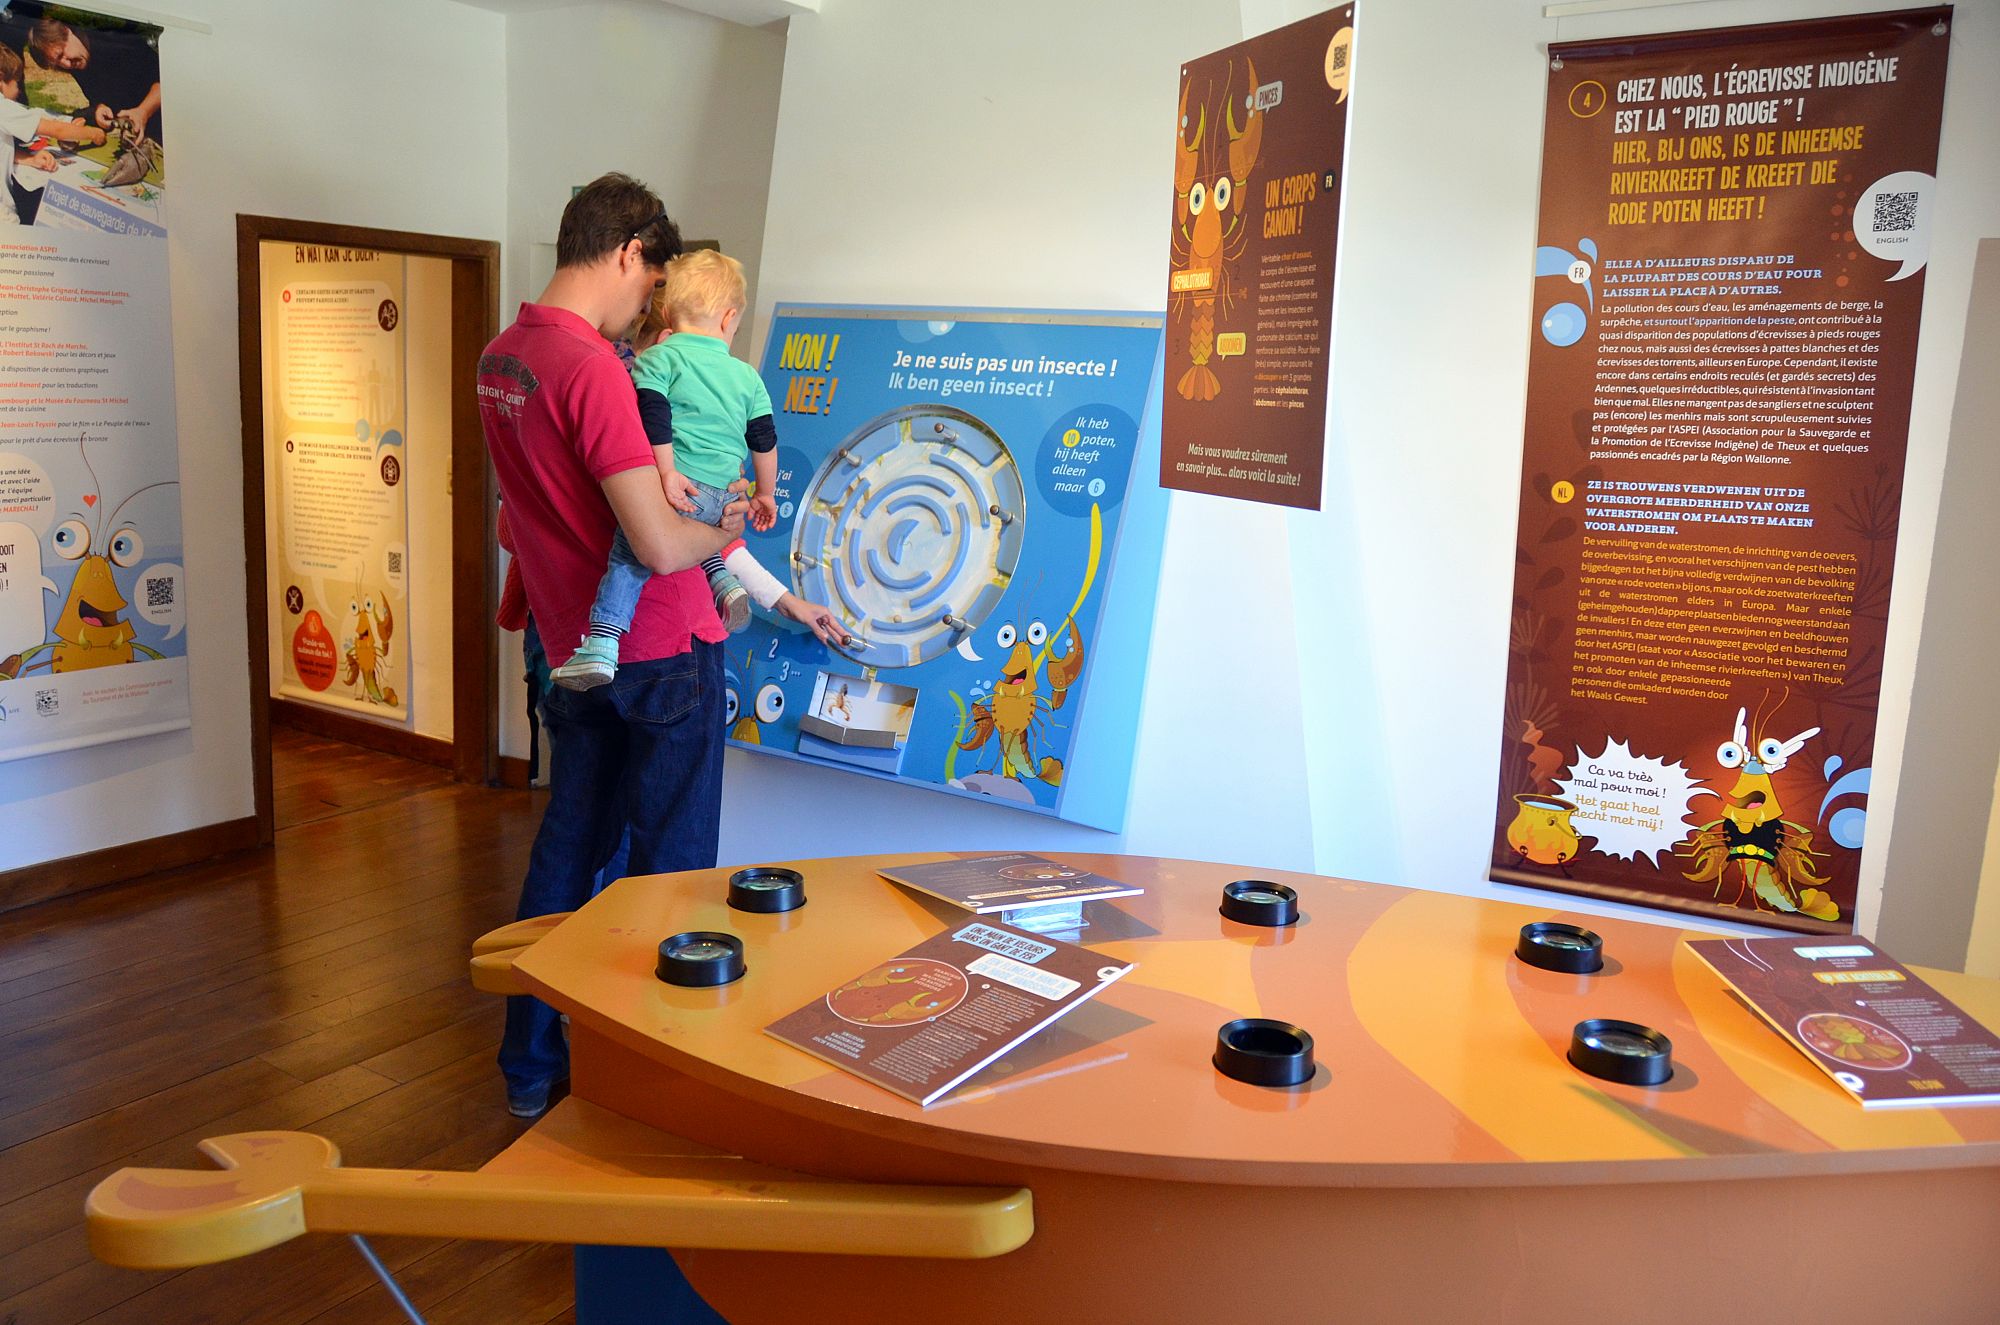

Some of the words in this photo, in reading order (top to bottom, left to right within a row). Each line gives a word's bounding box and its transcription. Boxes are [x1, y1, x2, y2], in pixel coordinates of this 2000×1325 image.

[1617, 77, 1654, 103] CHEZ
[1661, 73, 1707, 100] NOUS,
[1818, 52, 1899, 87] INDIGÈNE
[1259, 87, 1278, 107] PINCES
[1583, 91, 1591, 109] 4
[1614, 109, 1641, 134] EST
[1647, 108, 1665, 131] LA
[1684, 102, 1720, 129] PIED
[1725, 99, 1779, 126] ROUGE
[1613, 139, 1651, 165] HIER,
[1657, 135, 1684, 161] BIJ
[1689, 134, 1727, 160] ONS,
[1733, 132, 1749, 157] IS
[1755, 131, 1775, 156] DE
[1781, 125, 1864, 155] INHEEMSE
[1325, 175, 1333, 188] FR
[1611, 165, 1715, 195] RIVIERKREEFT
[1720, 163, 1740, 190] DE
[1745, 160, 1805, 189] KREEFT
[1811, 159, 1838, 184] DIE
[1265, 179, 1280, 208] UN
[1282, 172, 1317, 206] CORPS
[47, 185, 68, 206] Projet
[69, 196, 79, 211] de
[80, 203, 126, 233] sauvegarde
[1608, 199, 1646, 225] RODE
[1652, 197, 1701, 223] POTEN
[1707, 196, 1754, 221] HEEFT
[1263, 209, 1296, 239] CANON
[1876, 235, 1908, 244] ENGLISH
[296, 246, 304, 263] EN
[324, 247, 339, 262] KAN
[1605, 260, 1633, 269] ELLE
[1634, 260, 1642, 268] A
[1718, 255, 1773, 266] DISPARU
[1777, 255, 1794, 264] DE
[1574, 266, 1584, 278] FR
[1604, 274, 1618, 283] LA
[1620, 273, 1675, 282] PLUPART
[1677, 272, 1699, 282] DES
[1701, 271, 1741, 280] COURS
[1786, 269, 1822, 279] POUR
[1603, 287, 1651, 297] LAISSER
[1652, 287, 1667, 296] LA
[1670, 286, 1707, 296] PLACE
[1708, 284, 1716, 295] À
[1601, 305, 1611, 314] La
[1613, 304, 1654, 315] pollution
[1657, 304, 1672, 313] des
[1675, 304, 1699, 313] cours
[1732, 302, 1746, 311] les
[1748, 301, 1822, 314] aménagements
[1825, 301, 1837, 310] de
[1840, 300, 1871, 312] berge,
[1874, 300, 1883, 309] la
[779, 333, 827, 371] NON
[893, 351, 912, 368] Je
[915, 356, 935, 369] ne
[939, 352, 972, 371] suis
[976, 358, 1007, 375] pas
[1012, 359, 1033, 373] un
[1038, 357, 1105, 376] insecte
[889, 372, 903, 389] Ik
[907, 373, 938, 392] ben
[941, 380, 984, 396] geen
[989, 377, 1044, 397] insect
[784, 377, 825, 415] NEE
[1076, 417, 1084, 428] Ik
[1086, 417, 1108, 429] heb
[1066, 433, 1076, 444] 10
[1080, 434, 1116, 448] poten,
[1054, 448, 1068, 462] hij
[1070, 449, 1100, 464] heeft
[1188, 443, 1204, 456] Mais
[1205, 446, 1221, 457] vous
[1222, 447, 1250, 460] voudrez
[1251, 451, 1288, 465] sûrement
[1052, 465, 1086, 477] alleen
[1176, 463, 1184, 472] en
[1185, 462, 1204, 474] savoir
[1229, 467, 1247, 480] alors
[1249, 470, 1266, 482] voici
[1267, 470, 1275, 483] la
[1276, 472, 1296, 485] suite
[1054, 481, 1084, 492] maar
[1093, 482, 1100, 493] 6
[1558, 487, 1568, 498] NL
[1587, 481, 1601, 490] ZE
[1603, 481, 1614, 490] IS
[1616, 482, 1681, 492] TROUWENS
[1683, 484, 1761, 496] VERDWENEN
[1764, 487, 1786, 497] UIT
[1790, 489, 1805, 498] DE
[20, 496, 51, 504] particulier
[1586, 495, 1653, 505] OVERGROTE
[1655, 496, 1743, 509] MEERDERHEID
[1746, 500, 1772, 510] VAN
[1775, 502, 1810, 512] ONZE
[1586, 508, 1679, 520] WATERSTROMEN
[1682, 512, 1702, 522] OM
[1704, 513, 1749, 524] PLAATS
[1751, 516, 1766, 525] TE
[1767, 517, 1814, 527] MAKEN
[1585, 522, 1616, 531] VOOR
[1617, 522, 1679, 535] ANDEREN.
[769, 639, 778, 658] 2
[1570, 688, 1584, 697] het
[1587, 689, 1613, 700] Waals
[1614, 692, 1649, 705] Gewest.
[1588, 765, 1605, 776] Ca
[1608, 769, 1624, 779] va
[1628, 770, 1653, 783] très
[1574, 778, 1598, 789] mal
[1601, 782, 1632, 792] pour
[1635, 787, 1660, 797] moi
[1575, 794, 1597, 806] Het
[1600, 800, 1630, 810] gaat
[1633, 802, 1661, 815] heel
[1611, 815, 1635, 826] met
[1638, 819, 1657, 832] mij
[960, 932, 982, 942] DANS
[990, 942, 1011, 952] GANT
[1019, 951, 1036, 961] FER
[986, 931, 1007, 941] MAIN
[1013, 940, 1047, 954] VELOURS
